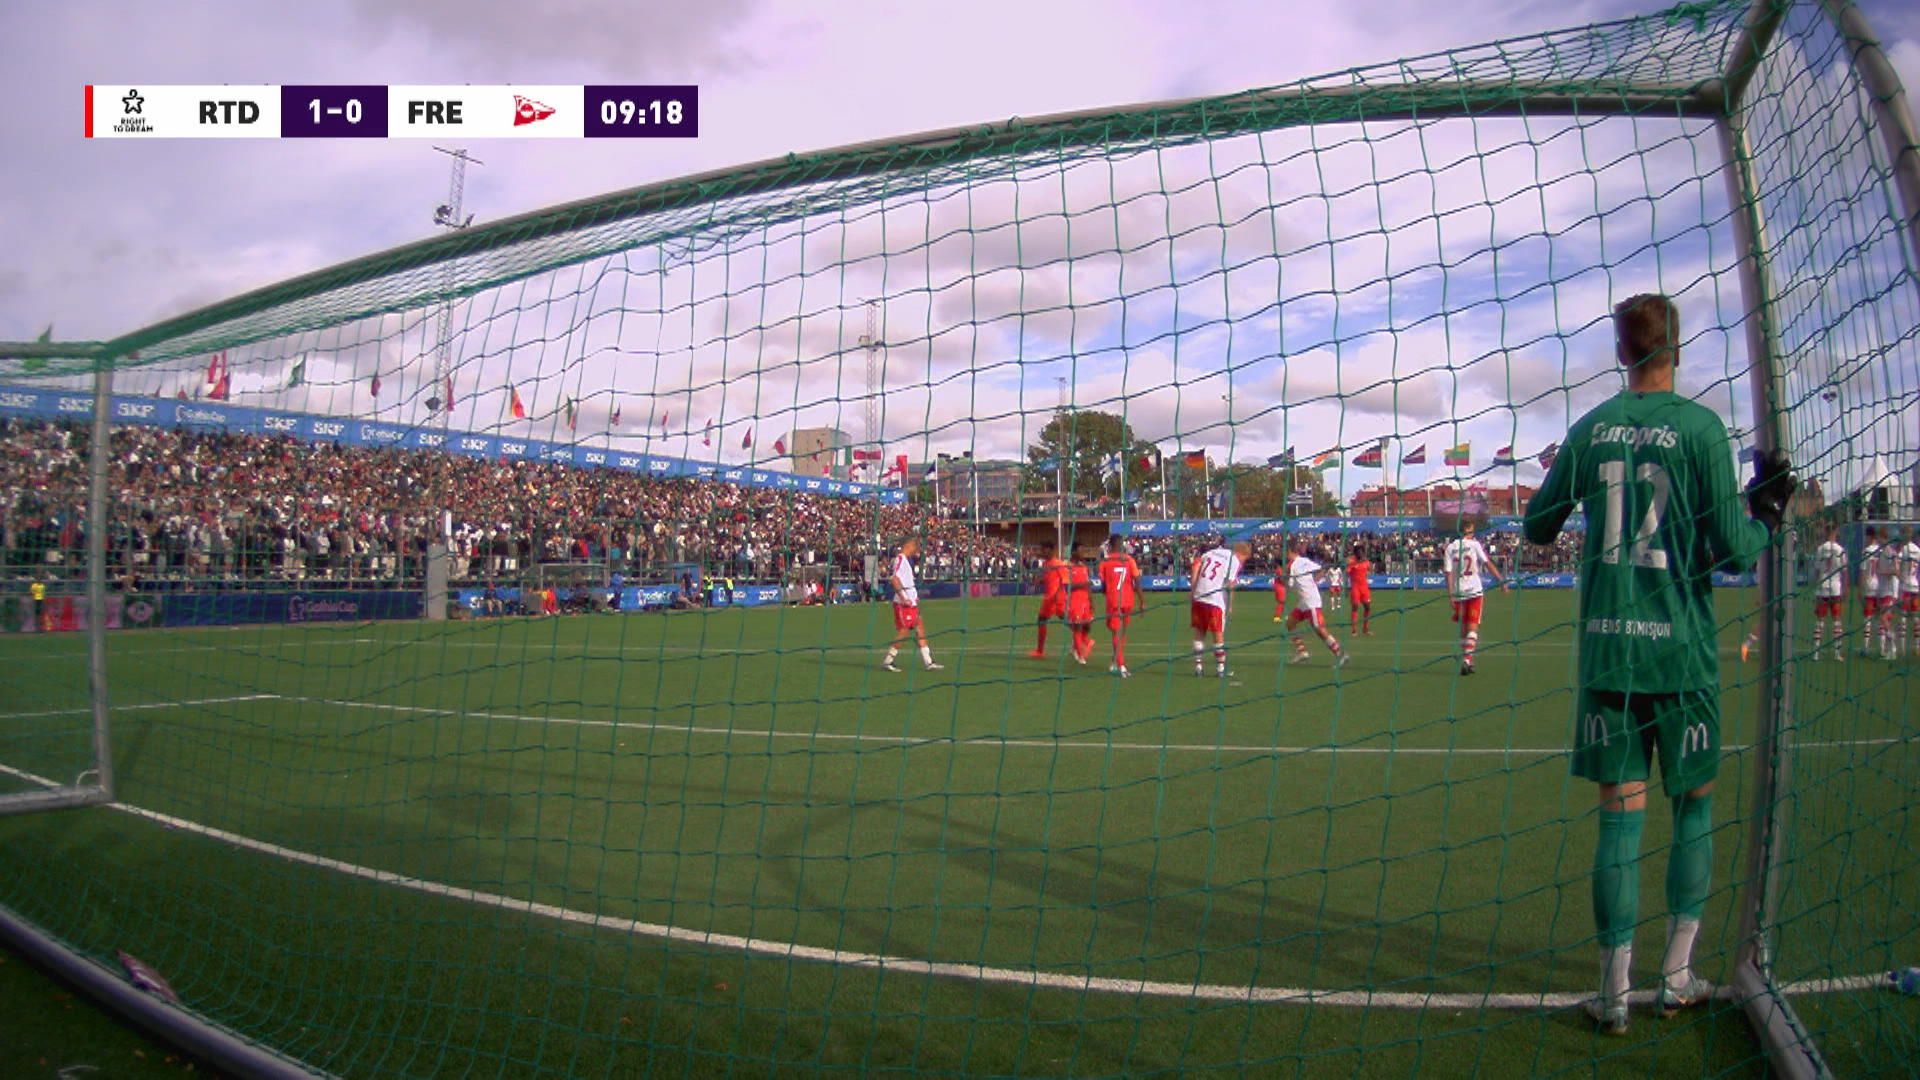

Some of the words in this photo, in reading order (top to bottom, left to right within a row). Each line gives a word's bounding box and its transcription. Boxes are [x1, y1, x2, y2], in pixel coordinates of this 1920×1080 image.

[118, 402, 155, 418] SKF
[264, 416, 298, 431] SKF
[313, 421, 345, 436] SKF
[1591, 421, 1678, 453] Europris
[502, 443, 527, 455] SKF
[1598, 461, 1671, 569] 12
[1113, 566, 1127, 591] 7
